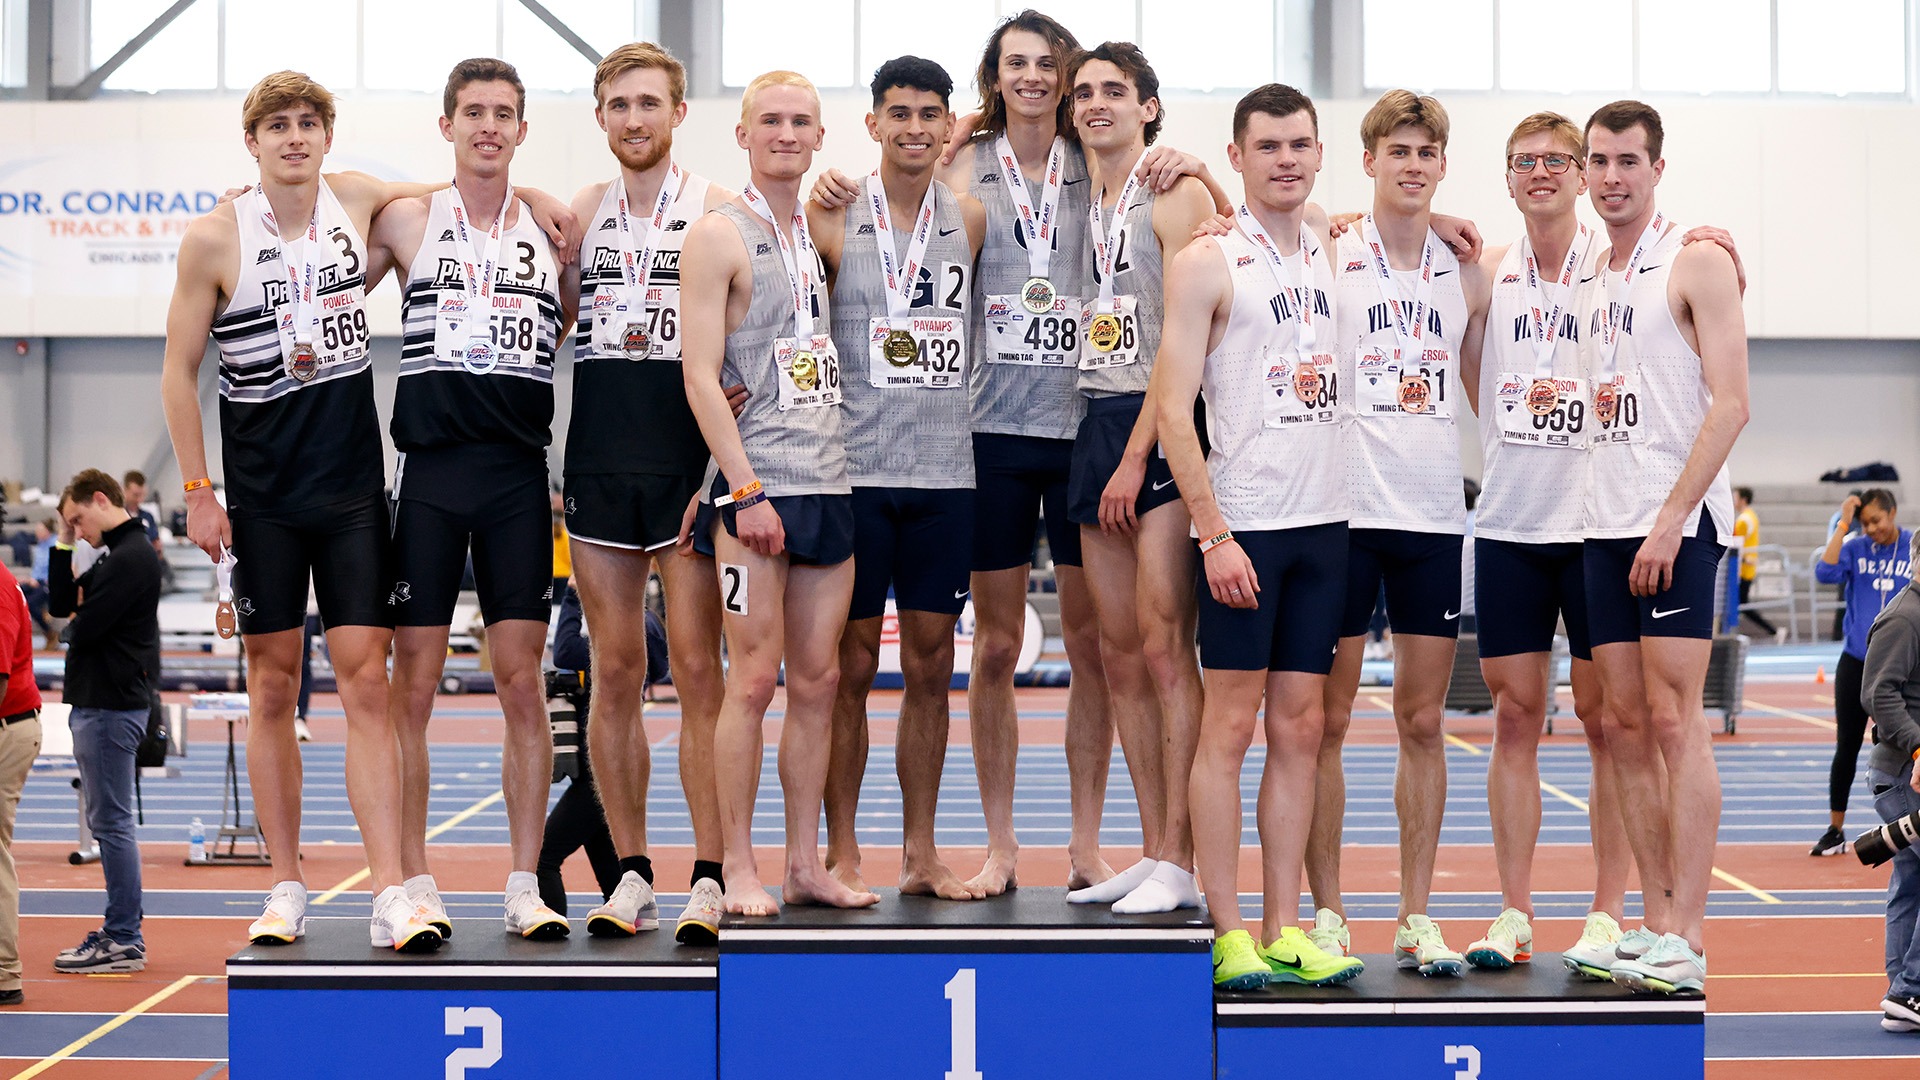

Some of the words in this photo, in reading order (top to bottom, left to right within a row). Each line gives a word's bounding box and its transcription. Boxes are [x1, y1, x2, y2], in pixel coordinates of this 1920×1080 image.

[1006, 156, 1014, 169] BIG
[1010, 168, 1021, 187] EAST
[0, 191, 50, 215] DR.
[62, 190, 217, 215] CONRAD
[873, 194, 882, 215] EAST
[1117, 199, 1126, 215] BIG
[1122, 179, 1135, 200] EAST
[653, 212, 661, 228] BIG
[658, 191, 669, 213] EAST
[923, 208, 931, 223] BIG
[1023, 205, 1031, 220] BIG
[48, 219, 129, 238] TRACK
[137, 219, 153, 238] &
[459, 220, 468, 243] EAST
[621, 211, 629, 233] EAST
[877, 214, 885, 231] BIG
[799, 229, 807, 251] EAST
[920, 222, 928, 245] EAST
[257, 252, 281, 262] EAST
[260, 246, 276, 256] BIG
[332, 232, 360, 276] 3
[1107, 236, 1115, 260] EAST
[1257, 233, 1270, 247] BIG
[1266, 245, 1282, 266] EAST
[1630, 245, 1643, 268] EAST
[483, 259, 491, 282] EAST
[515, 241, 536, 281] 3
[883, 250, 892, 274] EAST
[1237, 258, 1255, 266] EAST
[1345, 264, 1367, 272] EAST
[1373, 242, 1382, 257] BIG
[1378, 256, 1390, 279] EAST
[1567, 250, 1577, 272] EAST
[481, 281, 489, 297] BIG
[904, 277, 913, 299] EAST
[945, 265, 964, 310] 2
[323, 292, 355, 310] POWELL
[492, 296, 522, 309] DOLAN
[645, 308, 676, 342] 76
[913, 320, 953, 332] PAYAMPS
[1398, 312, 1408, 337] EAST
[1550, 304, 1559, 326] EAST
[322, 308, 367, 351] 569
[1024, 317, 1077, 352] 438
[323, 354, 336, 364] TAG
[913, 338, 960, 373] 432
[998, 352, 1019, 361] TIMING
[1312, 354, 1333, 366] NOVAN
[887, 376, 911, 384] TIMING
[912, 376, 924, 384] TAG
[1280, 415, 1302, 424] TIMING
[1303, 414, 1313, 422] TAG
[1372, 404, 1396, 412] TIMING
[1504, 430, 1527, 441] TIMING
[1528, 433, 1540, 441] TAG
[725, 567, 741, 612] 2
[943, 968, 983, 1080] 1
[445, 1006, 503, 1080] 2
